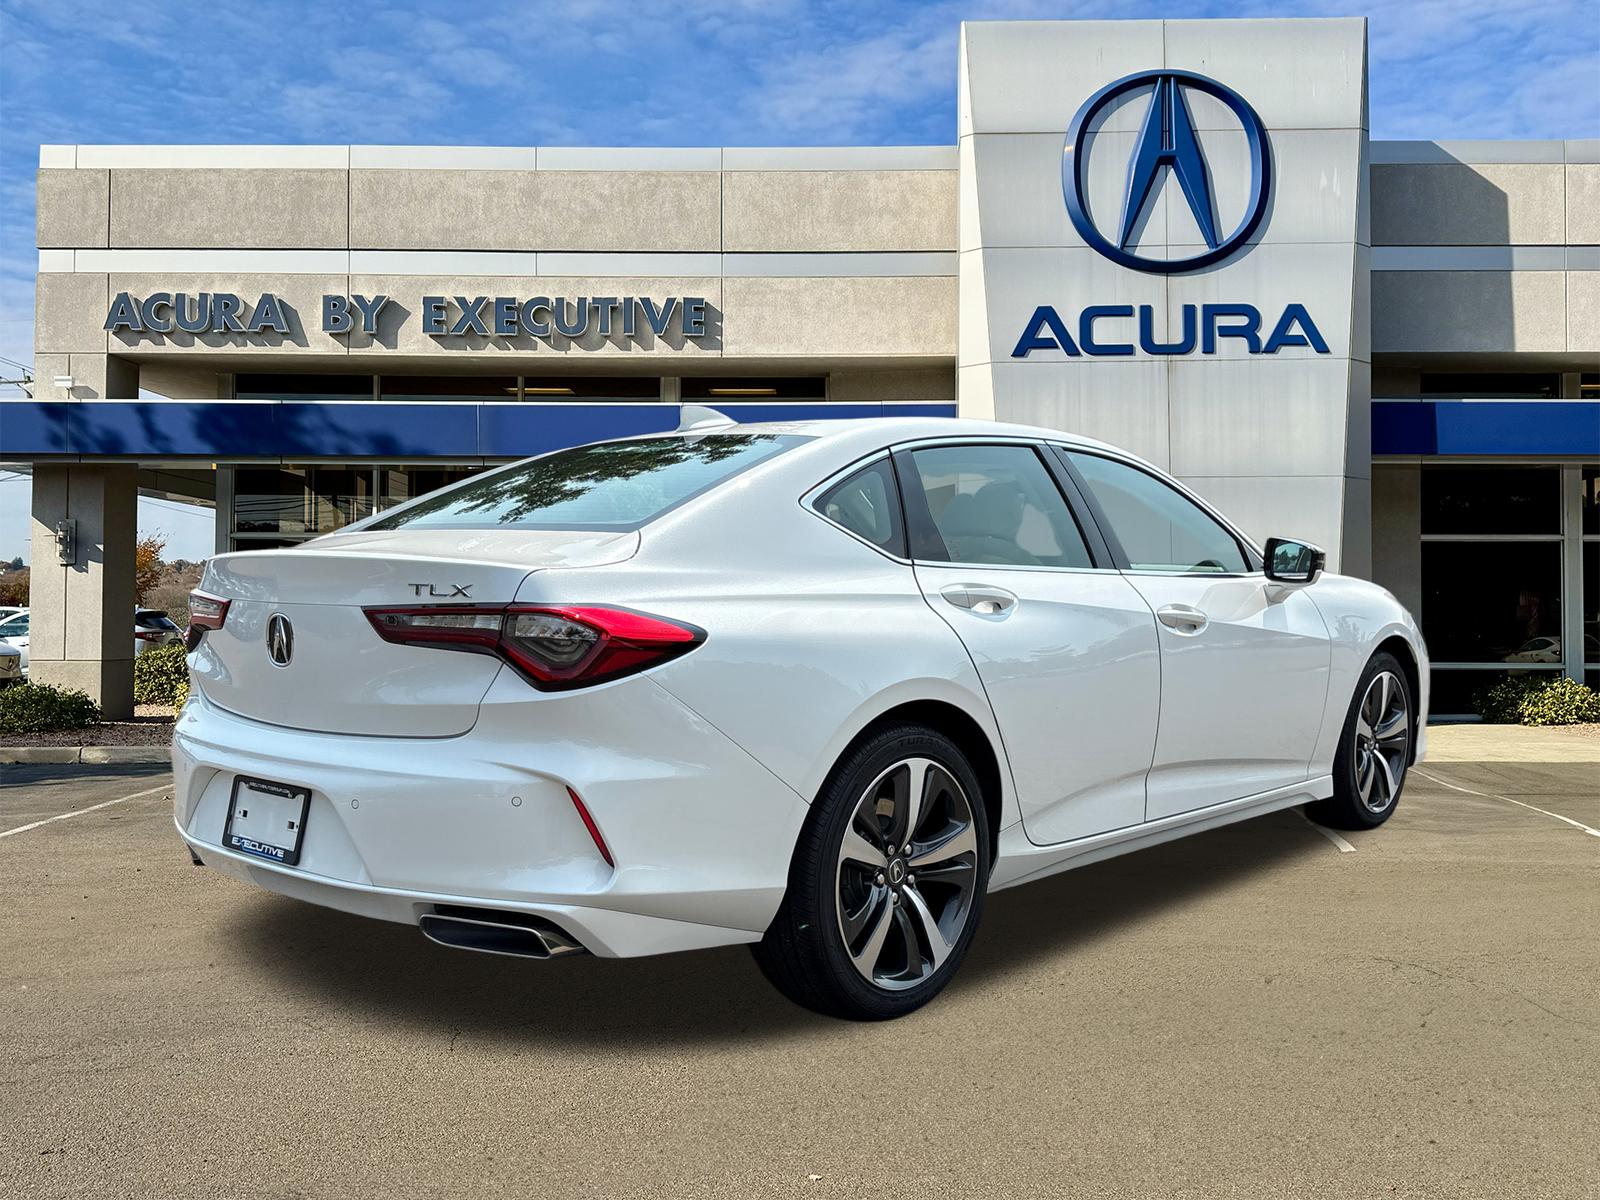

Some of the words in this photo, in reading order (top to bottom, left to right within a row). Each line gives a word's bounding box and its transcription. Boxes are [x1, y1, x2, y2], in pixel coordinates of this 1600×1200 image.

[103, 292, 290, 333] ACURA
[322, 294, 390, 334] BY
[422, 296, 706, 337] EXECUTIVE
[1010, 303, 1332, 357] ACURA
[408, 583, 473, 598] TLX
[231, 836, 285, 858] EXECUTIVE
